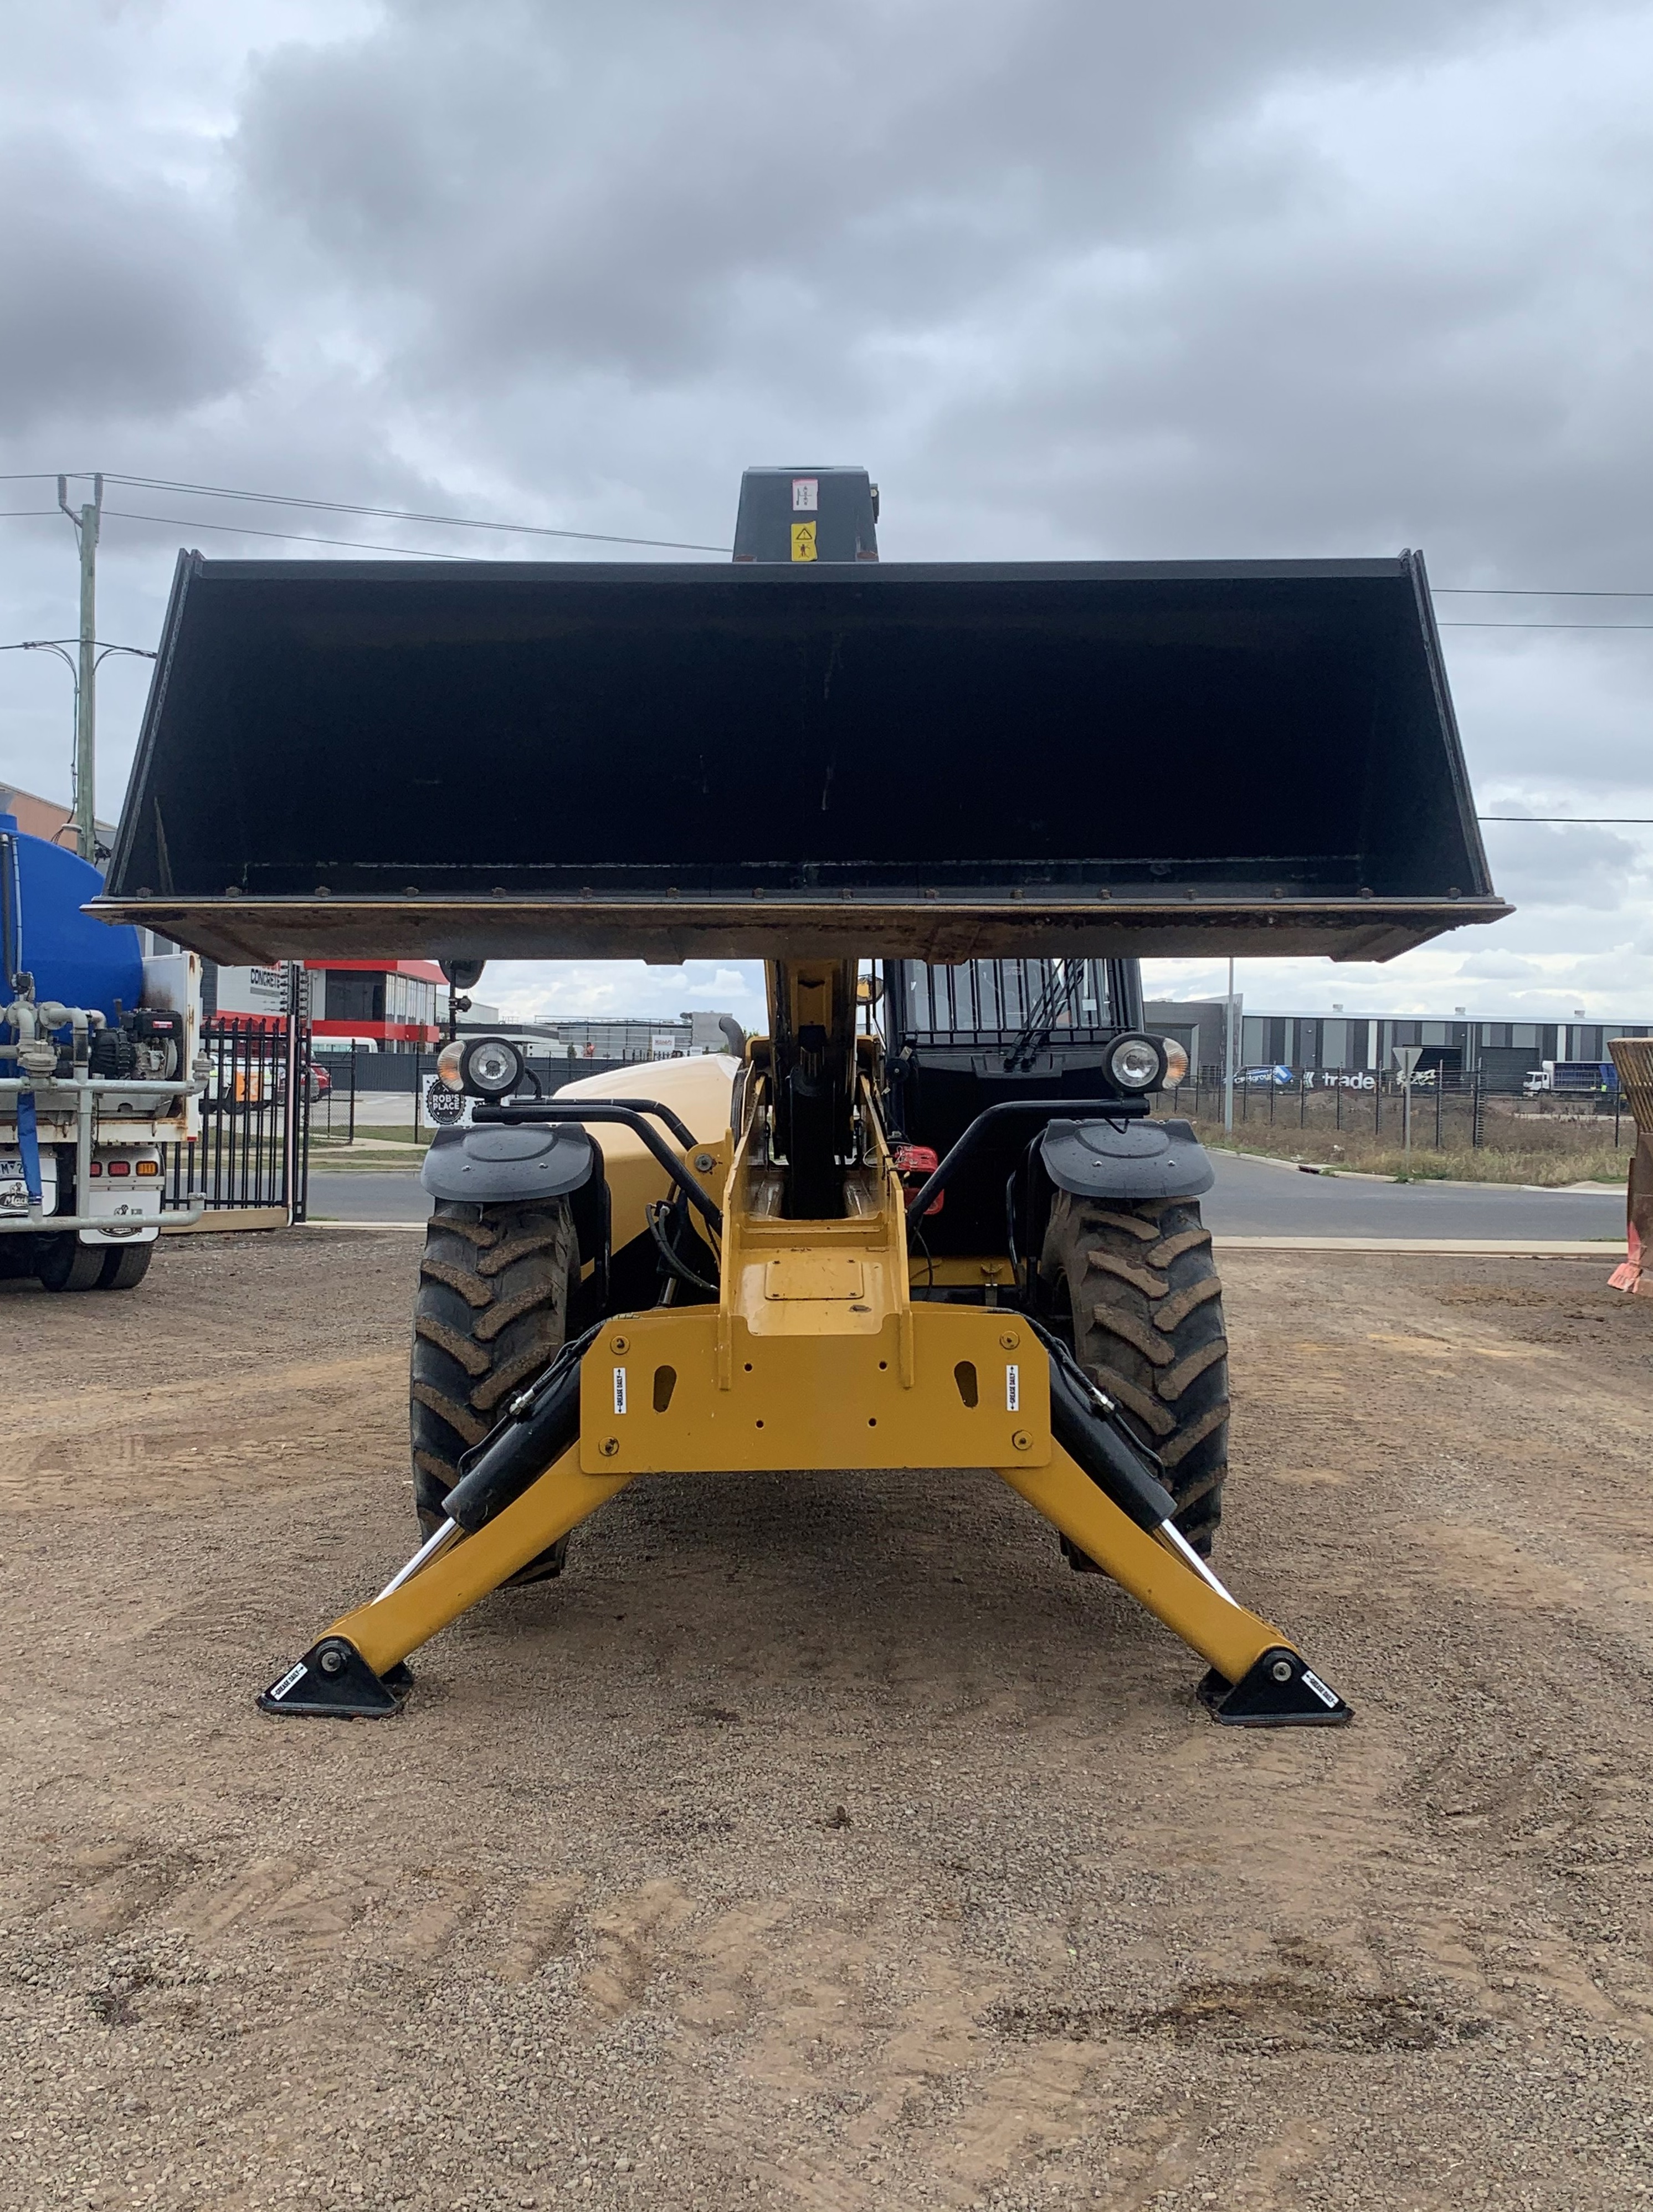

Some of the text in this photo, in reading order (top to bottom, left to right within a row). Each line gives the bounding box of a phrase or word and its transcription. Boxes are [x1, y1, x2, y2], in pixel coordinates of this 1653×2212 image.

[1322, 1072, 1375, 1089] trade
[433, 1094, 459, 1103] ROB'S
[275, 1670, 300, 1695] GREASE DAILY
[1310, 1678, 1334, 1702] GREASE DAILY
